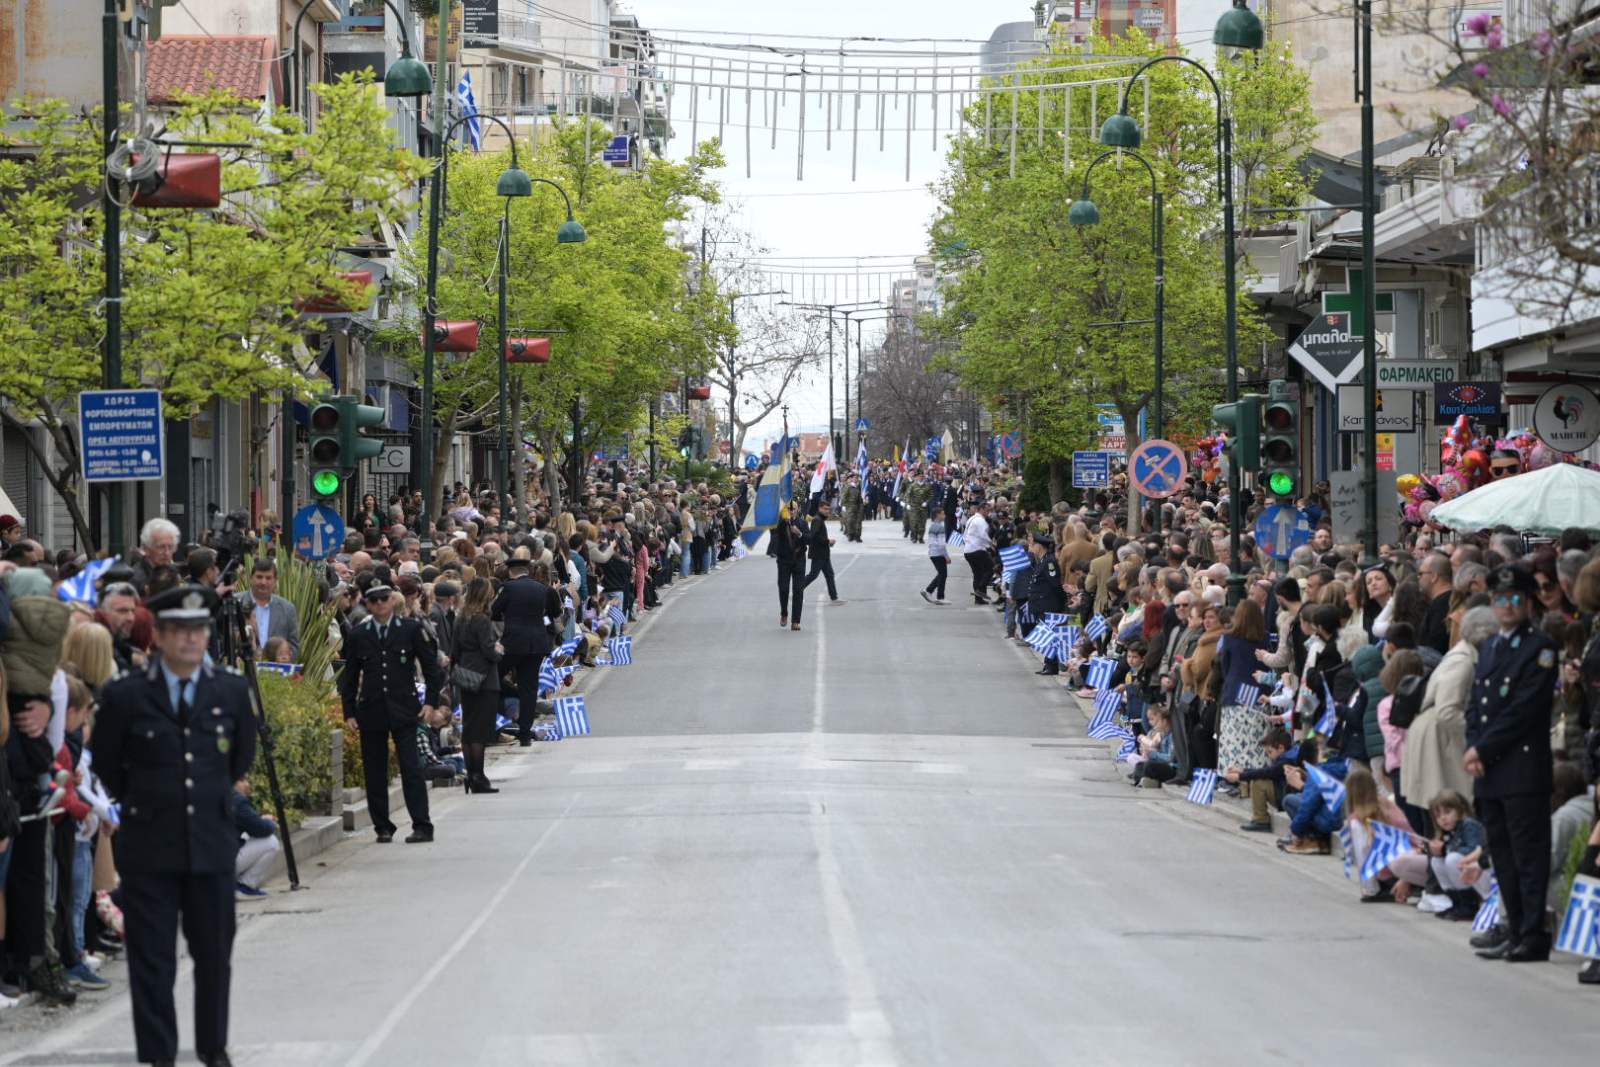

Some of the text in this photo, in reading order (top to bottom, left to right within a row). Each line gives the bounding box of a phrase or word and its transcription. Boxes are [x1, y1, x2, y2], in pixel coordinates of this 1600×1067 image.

[1379, 367, 1454, 383] ΦΑΡΜΑΚΕΙΟ
[104, 397, 136, 405] ΧΩΡΟΣ
[89, 421, 153, 430] ΕΜΠΟΡΕΥΜΑΤΩΝ
